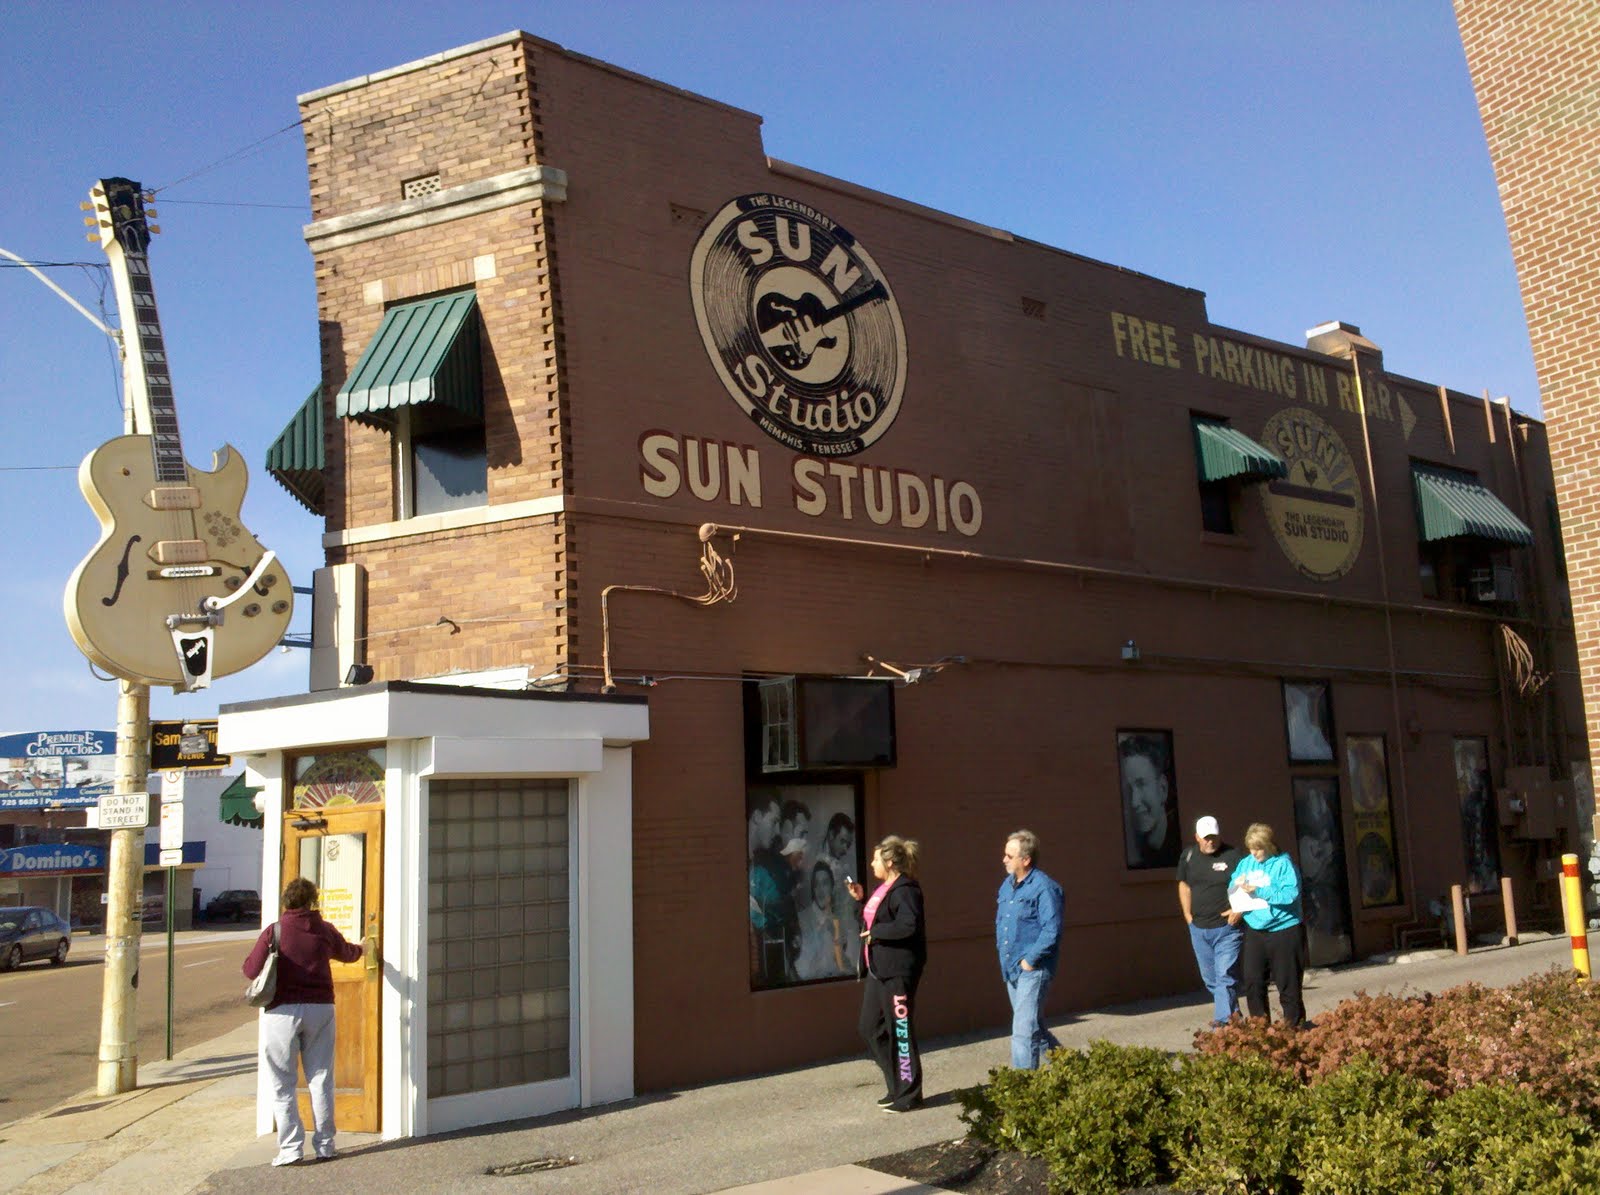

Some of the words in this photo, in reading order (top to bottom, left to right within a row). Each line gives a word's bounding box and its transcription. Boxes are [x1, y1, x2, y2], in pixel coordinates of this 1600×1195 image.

[750, 195, 770, 207] THE
[771, 196, 837, 231] LEGENDARY
[737, 215, 863, 295] SUN
[1111, 311, 1181, 369] FREE
[1193, 333, 1297, 399] PARKING
[1302, 362, 1329, 407] IN
[735, 354, 877, 433] Studio
[812, 440, 858, 454] TENESSEE
[1276, 420, 1338, 471] SUN
[640, 433, 762, 508] SUN
[793, 457, 983, 537] STUDIO
[1284, 521, 1308, 537] SUN
[1310, 526, 1349, 543] STUDIO
[1285, 511, 1300, 522] THE
[1302, 513, 1345, 529] LEGENDARY
[155, 732, 182, 746] Sam
[103, 807, 131, 815] STAND
[107, 798, 119, 806] DO
[123, 797, 140, 805] NOT
[107, 814, 140, 824] STREET
[12, 850, 98, 870] Domino's
[893, 994, 909, 1039] LOVE
[898, 1042, 913, 1084] PINK
